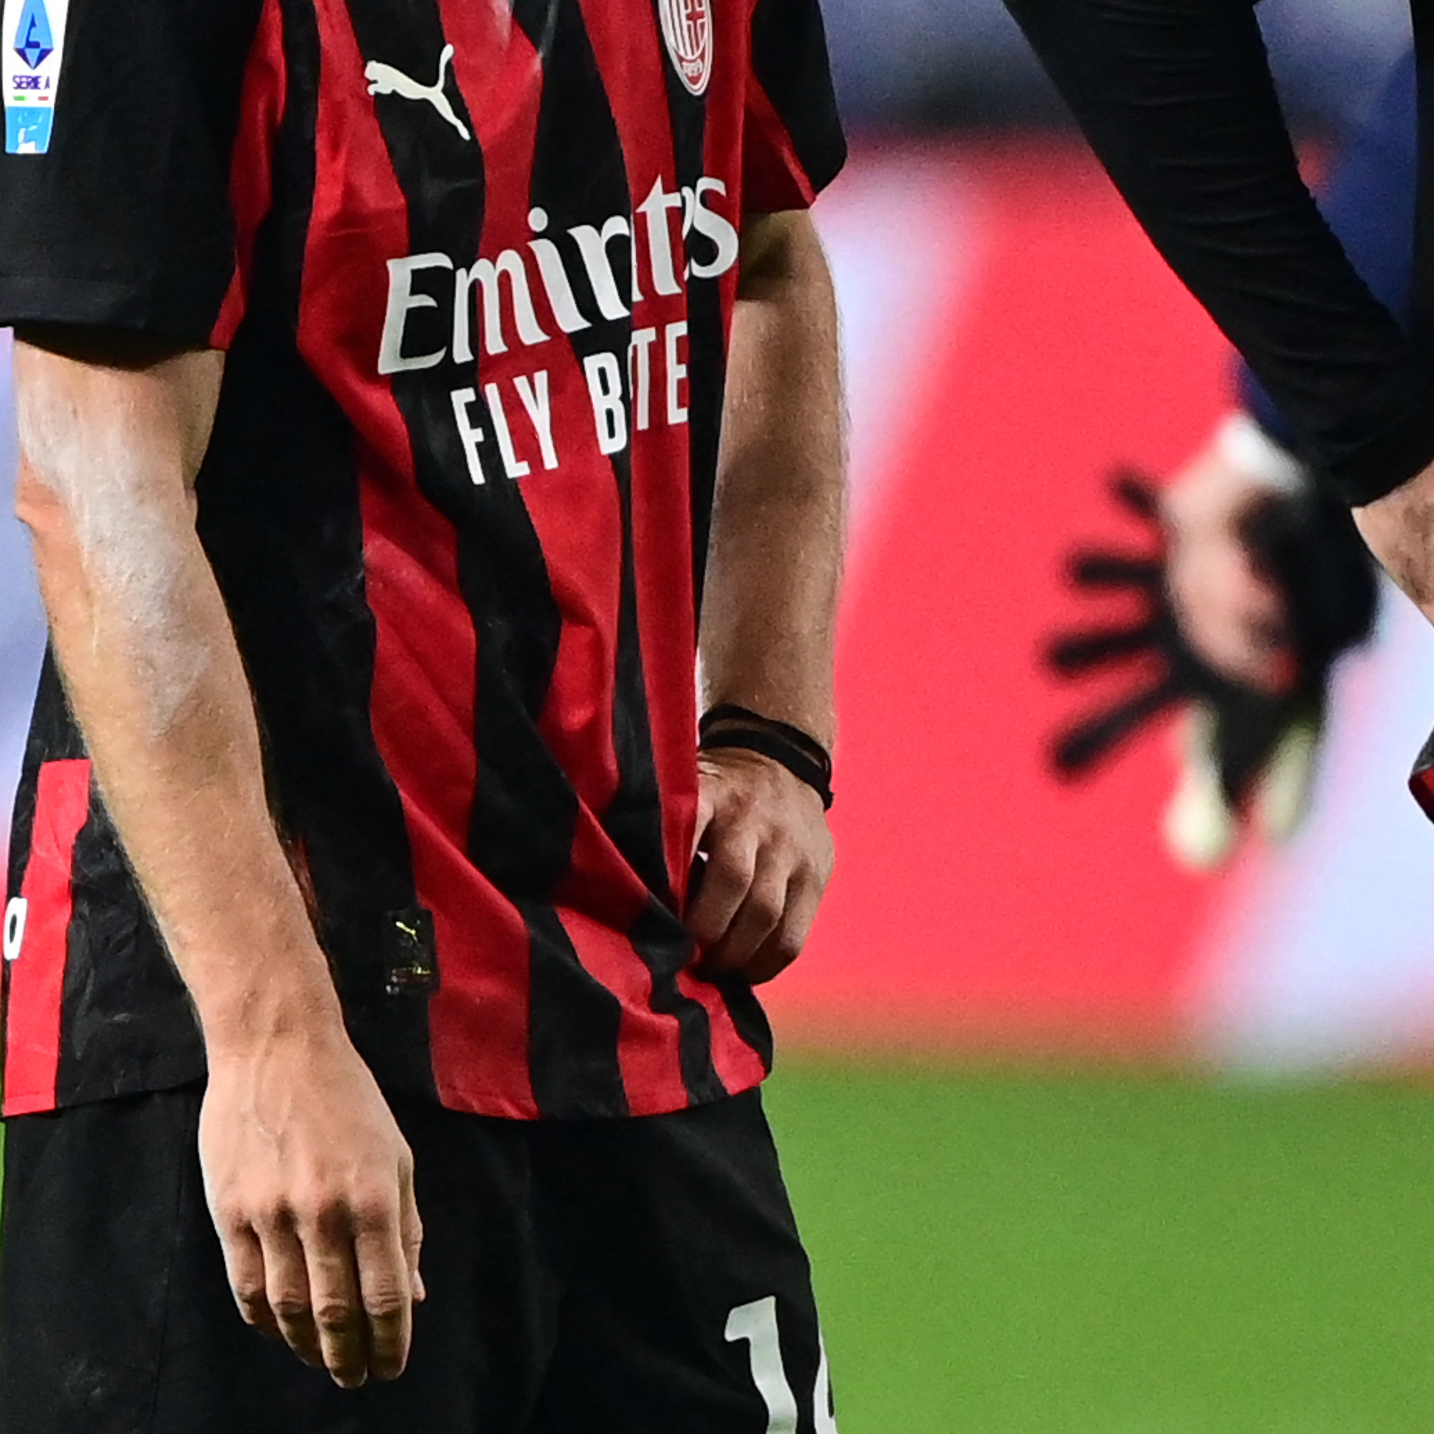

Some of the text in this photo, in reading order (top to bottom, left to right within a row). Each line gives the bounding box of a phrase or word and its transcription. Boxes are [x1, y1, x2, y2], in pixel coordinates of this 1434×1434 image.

[377, 173, 740, 375] Emirts
[450, 370, 560, 486] FLY
[723, 1294, 839, 1434] 1
